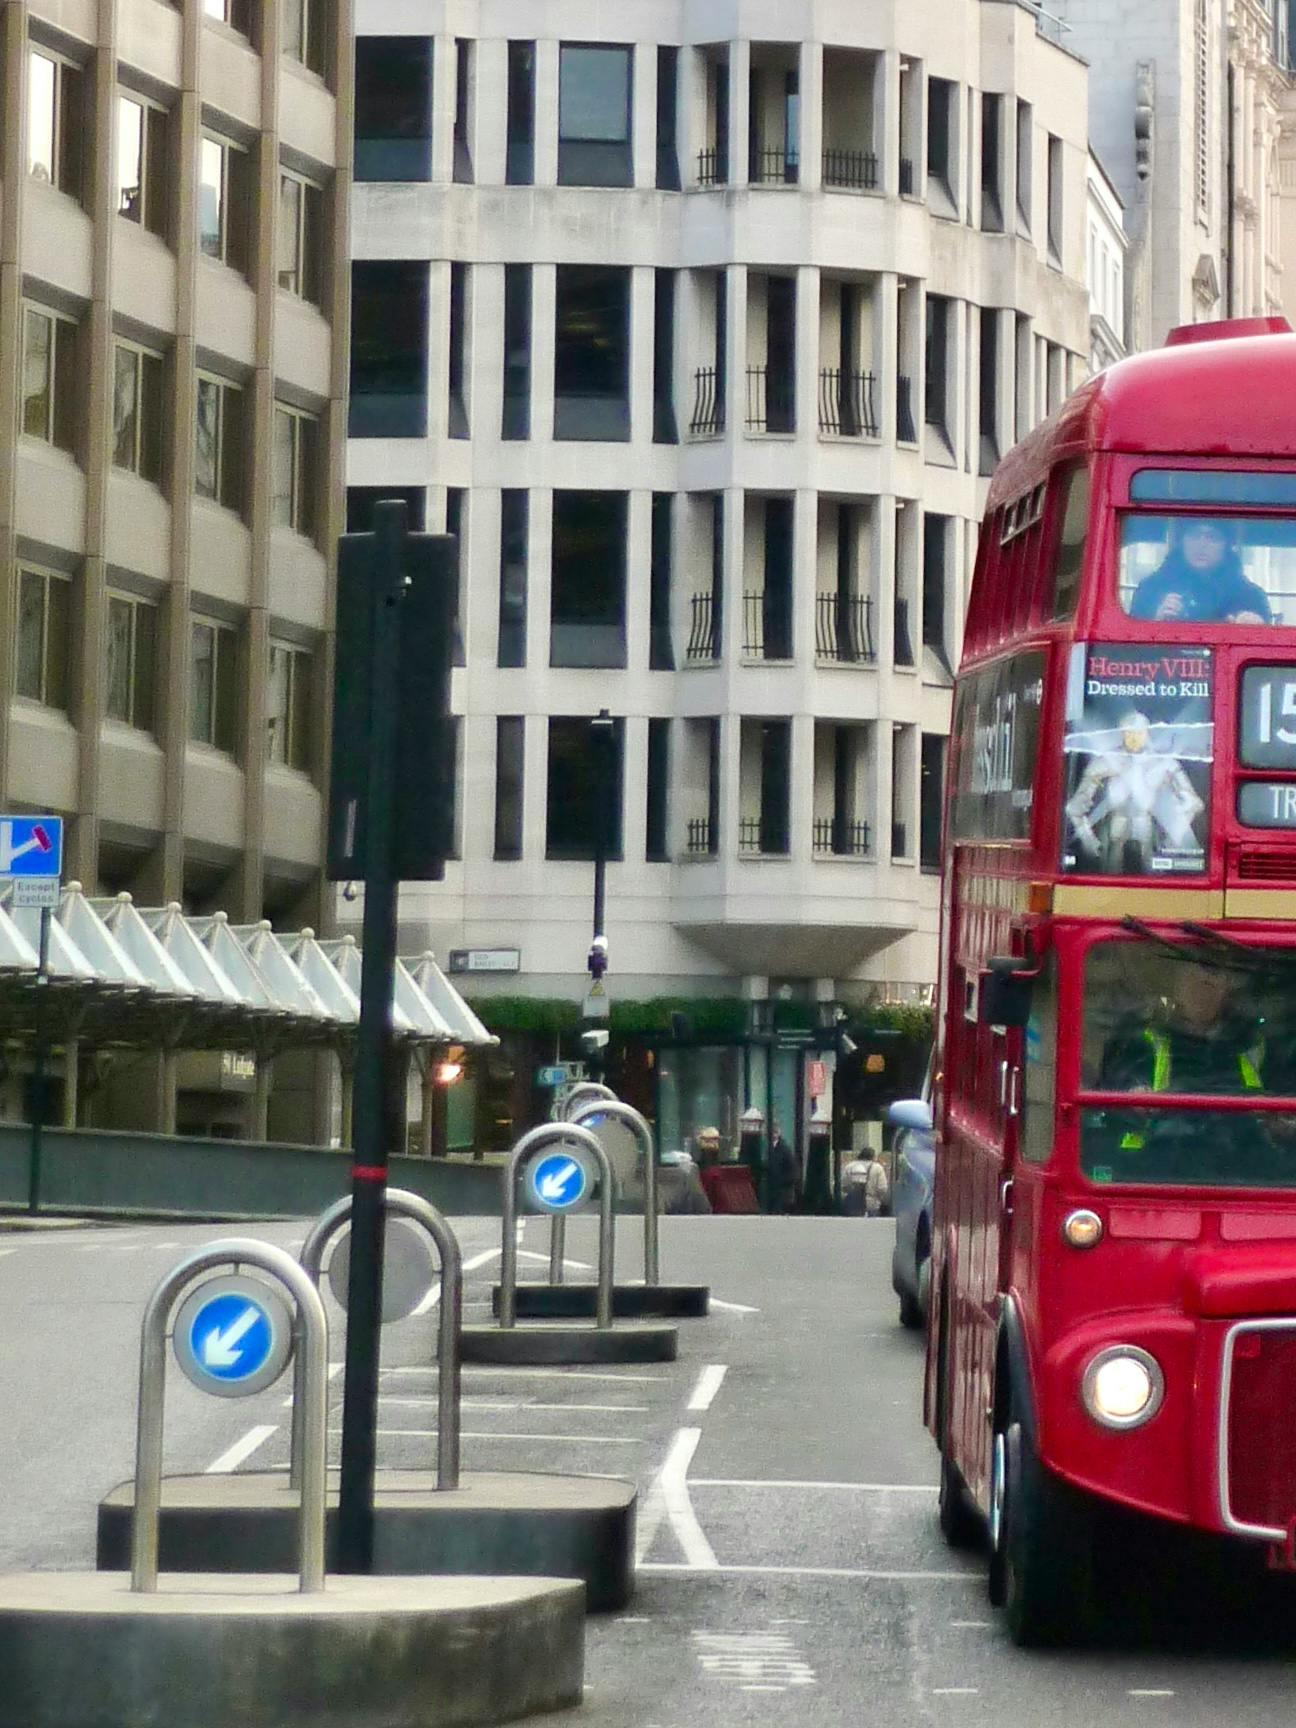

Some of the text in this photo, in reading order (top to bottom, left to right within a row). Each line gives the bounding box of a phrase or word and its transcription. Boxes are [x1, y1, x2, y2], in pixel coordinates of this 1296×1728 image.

[1088, 657, 1160, 681] Henry
[1088, 680, 1210, 697] Dressed to Kill
